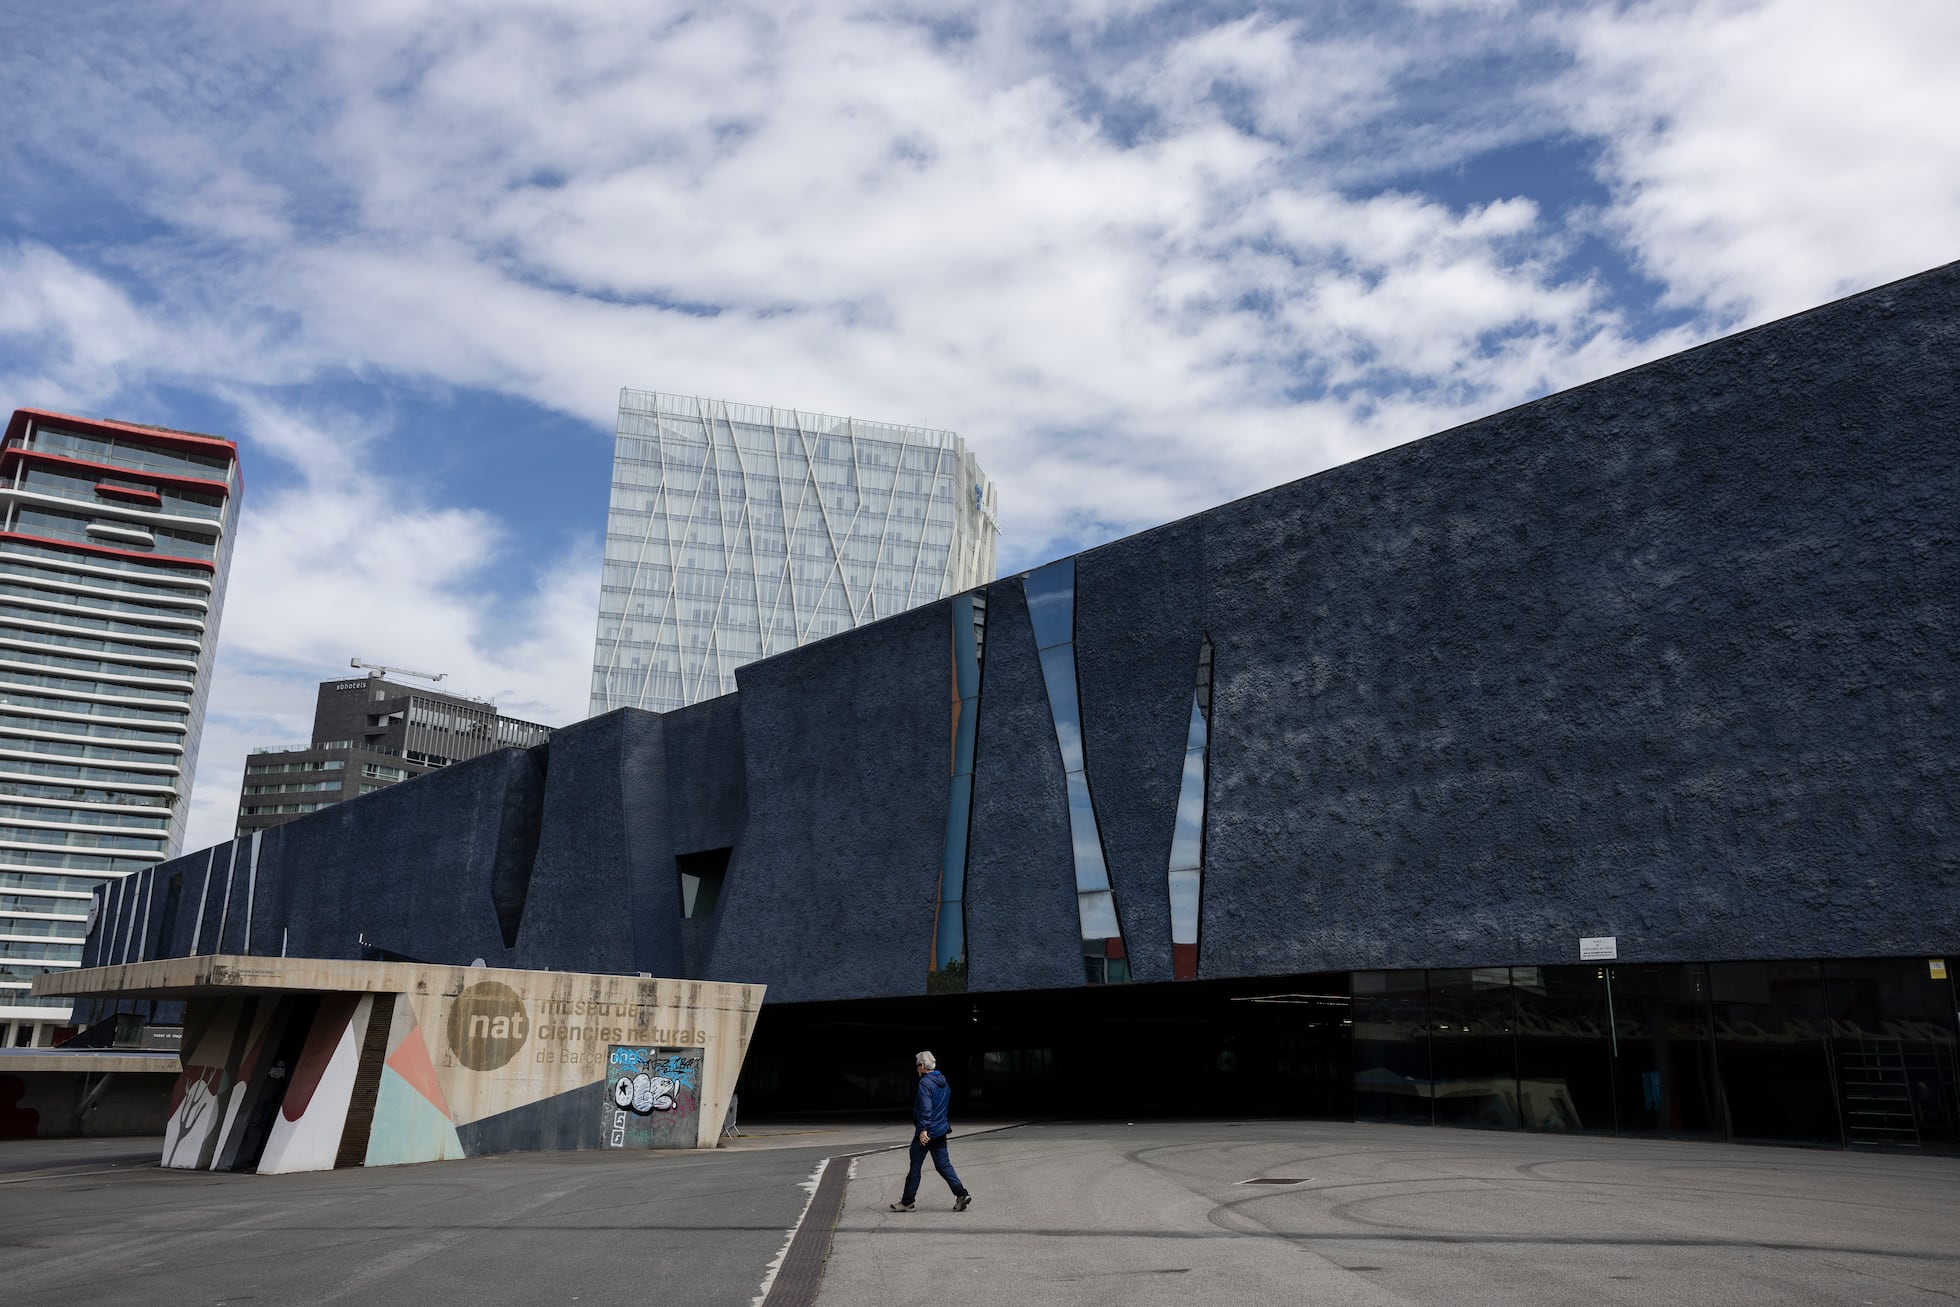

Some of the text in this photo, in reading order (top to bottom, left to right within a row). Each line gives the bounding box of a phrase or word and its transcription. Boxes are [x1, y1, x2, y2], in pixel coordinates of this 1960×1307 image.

[540, 998, 639, 1018] museu de
[468, 1011, 524, 1040] nat
[627, 1025, 706, 1045] naturals
[536, 1047, 555, 1063] de
